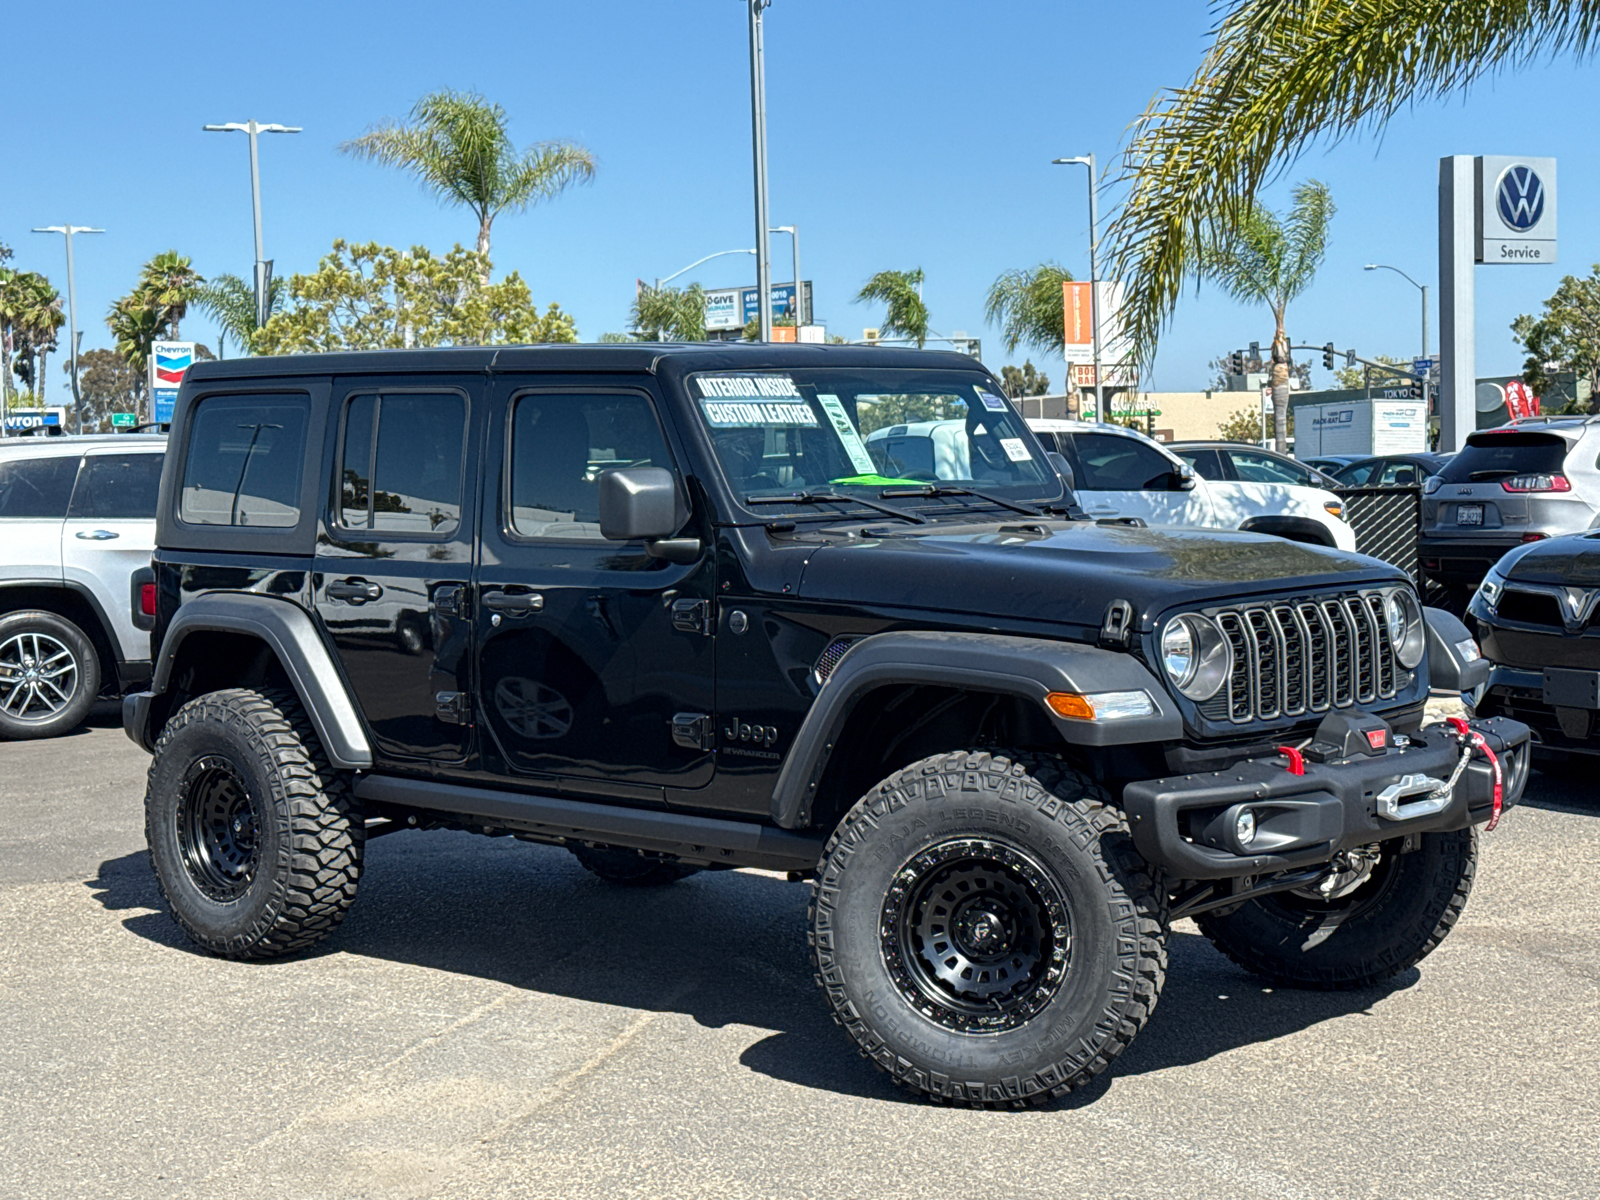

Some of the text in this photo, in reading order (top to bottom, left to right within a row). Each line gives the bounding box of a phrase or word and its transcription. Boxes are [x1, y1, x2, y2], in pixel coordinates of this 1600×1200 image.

[1500, 244, 1541, 259] Service
[155, 345, 191, 353] Chevron
[696, 377, 800, 397] INTERIOR INSIDE
[1384, 388, 1409, 399] TOKYO
[5, 416, 43, 427] vron
[705, 403, 818, 424] CUSTOM LEATHER
[724, 717, 778, 748] Jeep
[731, 747, 781, 760] WRANGLER
[873, 817, 928, 860] BAJA
[939, 806, 1032, 835] LEGEND
[863, 989, 1076, 1069] MICKEY THOMPSON
